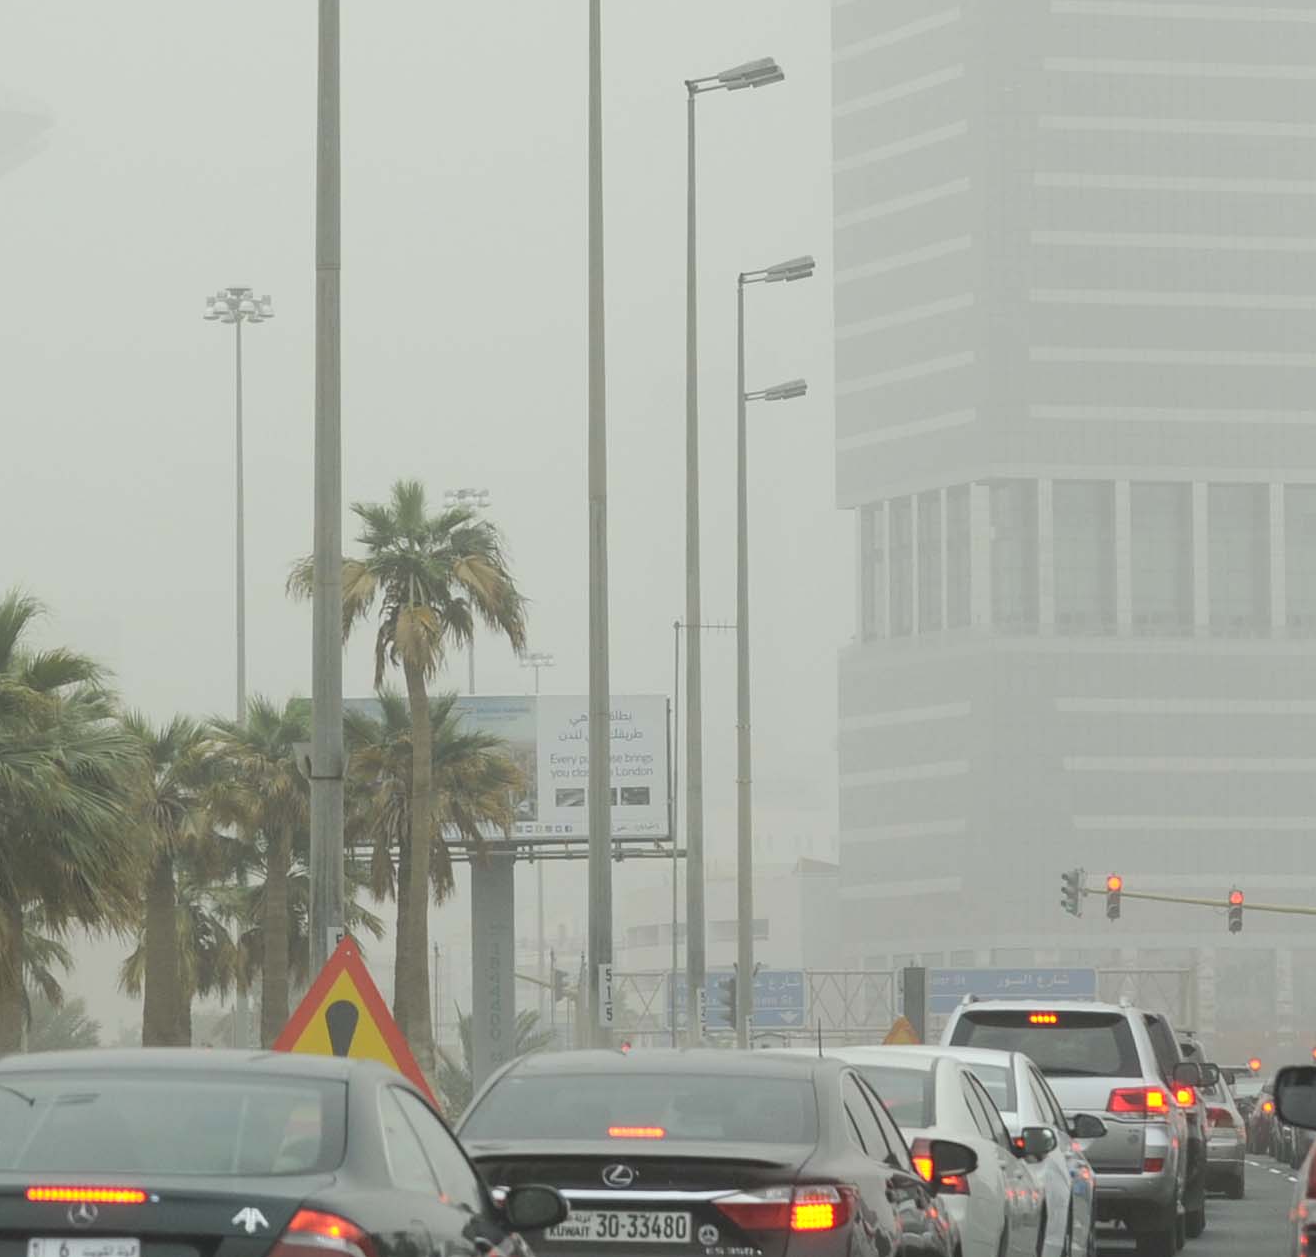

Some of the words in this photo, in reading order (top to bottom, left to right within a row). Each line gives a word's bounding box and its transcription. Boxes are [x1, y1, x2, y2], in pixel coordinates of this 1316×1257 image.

[550, 752, 575, 766] Every
[625, 750, 654, 765] brings
[550, 768, 569, 780] you
[615, 764, 654, 777] London
[549, 1224, 591, 1238] KUWAIT
[596, 1213, 688, 1239] 30-33480
